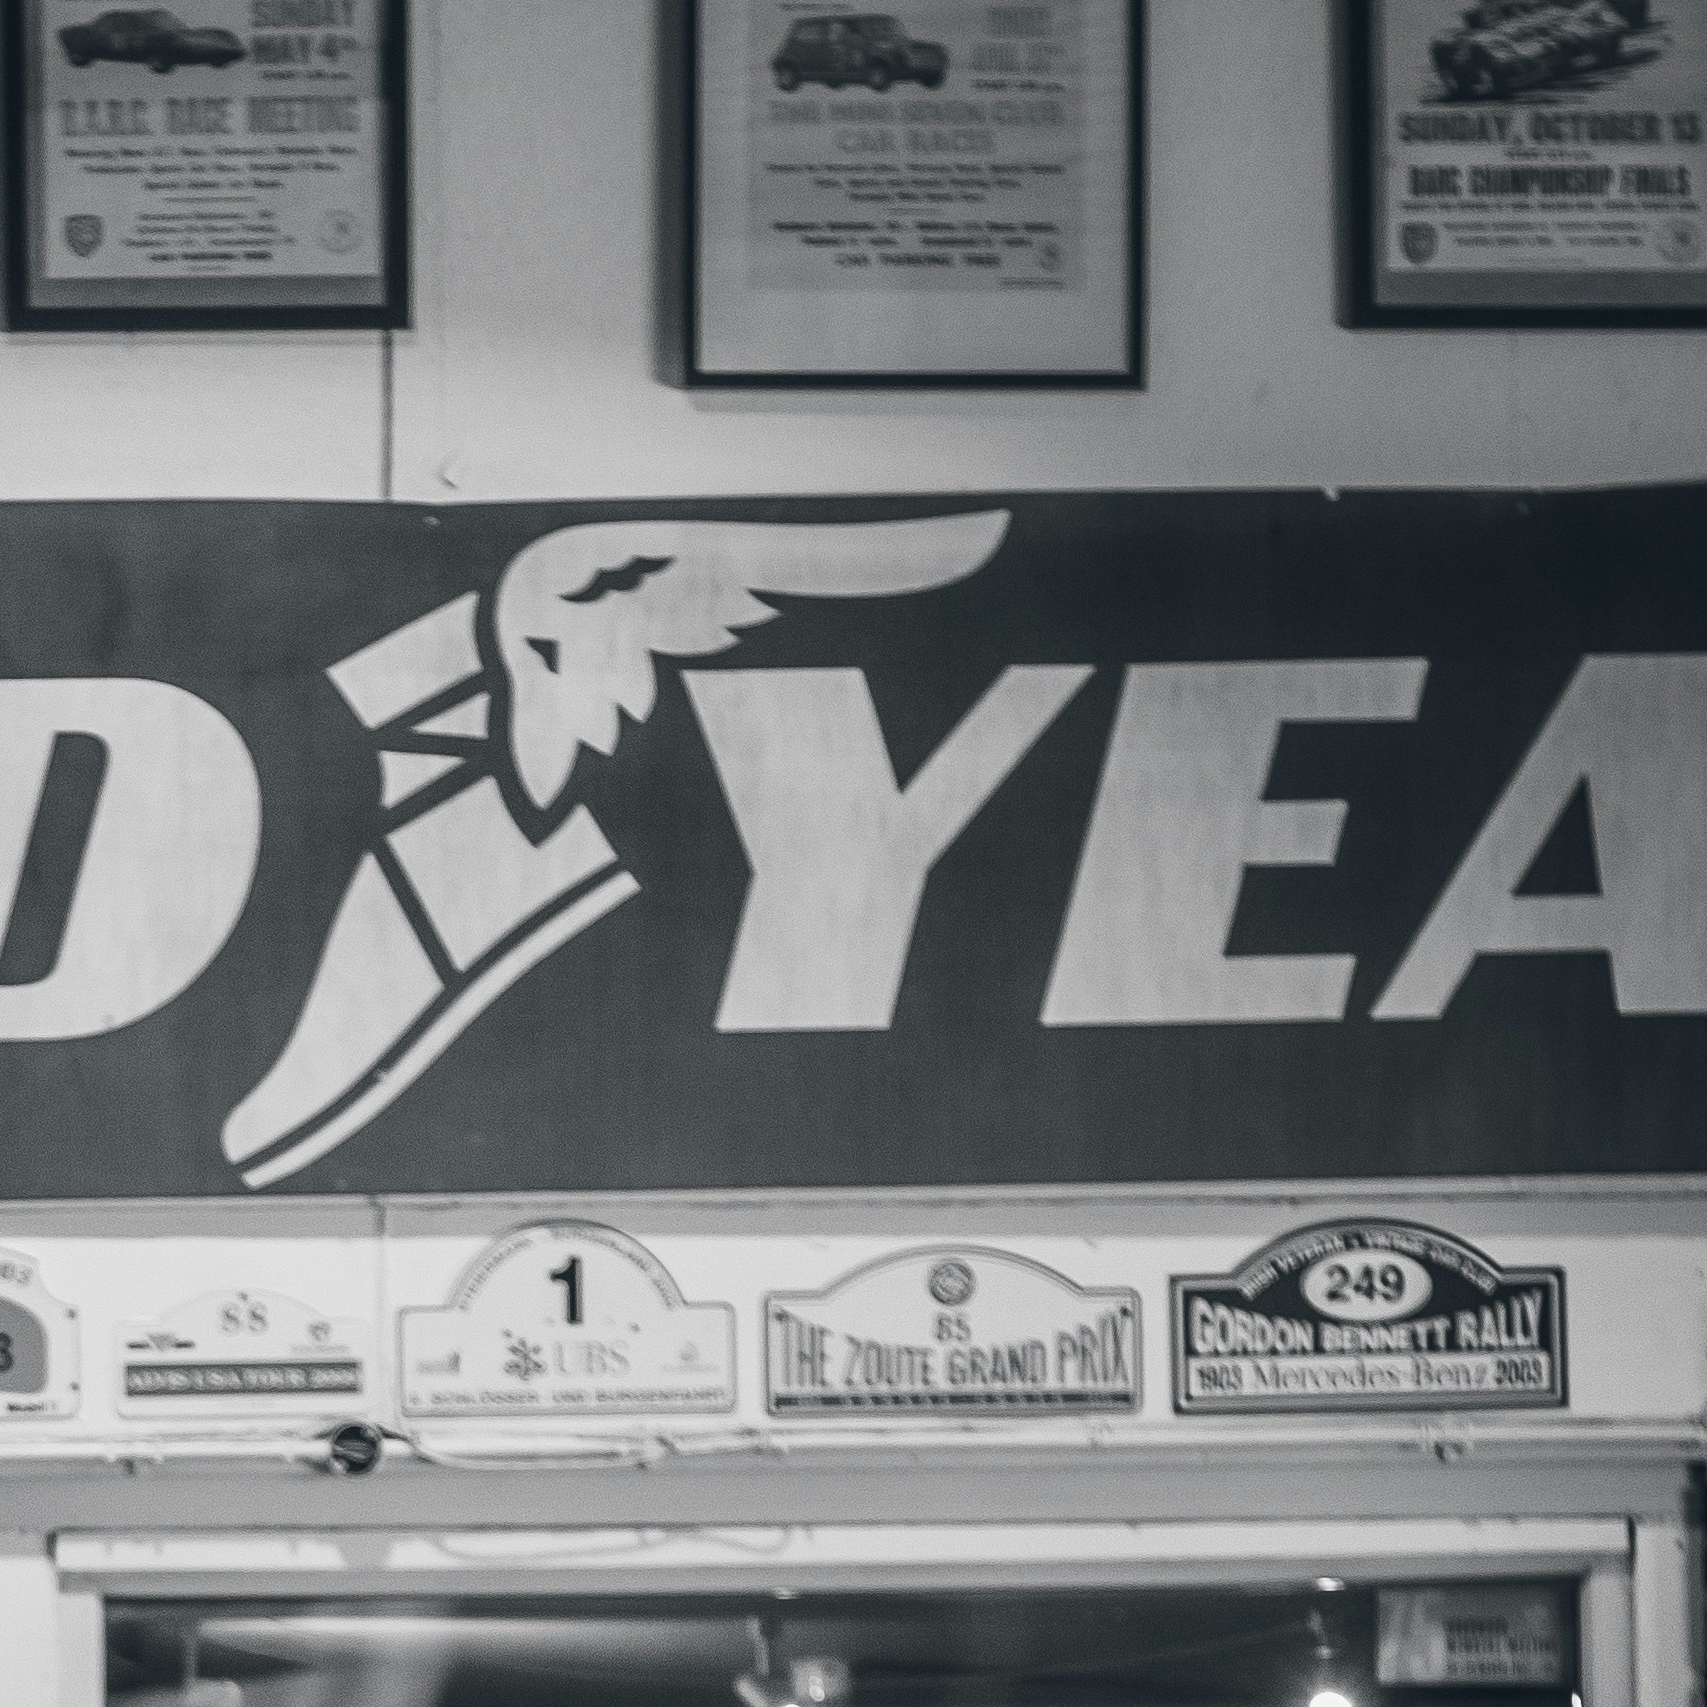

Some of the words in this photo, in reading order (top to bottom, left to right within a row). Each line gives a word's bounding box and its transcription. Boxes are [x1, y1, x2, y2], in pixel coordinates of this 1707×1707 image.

[1530, 112, 1660, 142] OCTOBER
[549, 1254, 583, 1325] 1
[1323, 1263, 1407, 1303] 249
[1190, 1294, 1314, 1353] GORDON
[1318, 1318, 1452, 1351] BENNETT
[1456, 1286, 1543, 1351] RALLY
[553, 1340, 631, 1376] UBS
[777, 1315, 831, 1387] THE
[843, 1333, 933, 1386] ZOUTE
[944, 1338, 1048, 1385] GRAND
[1056, 1310, 1129, 1382] PRIX
[1197, 1364, 1243, 1391] 1903
[1496, 1358, 1544, 1385] 2003
